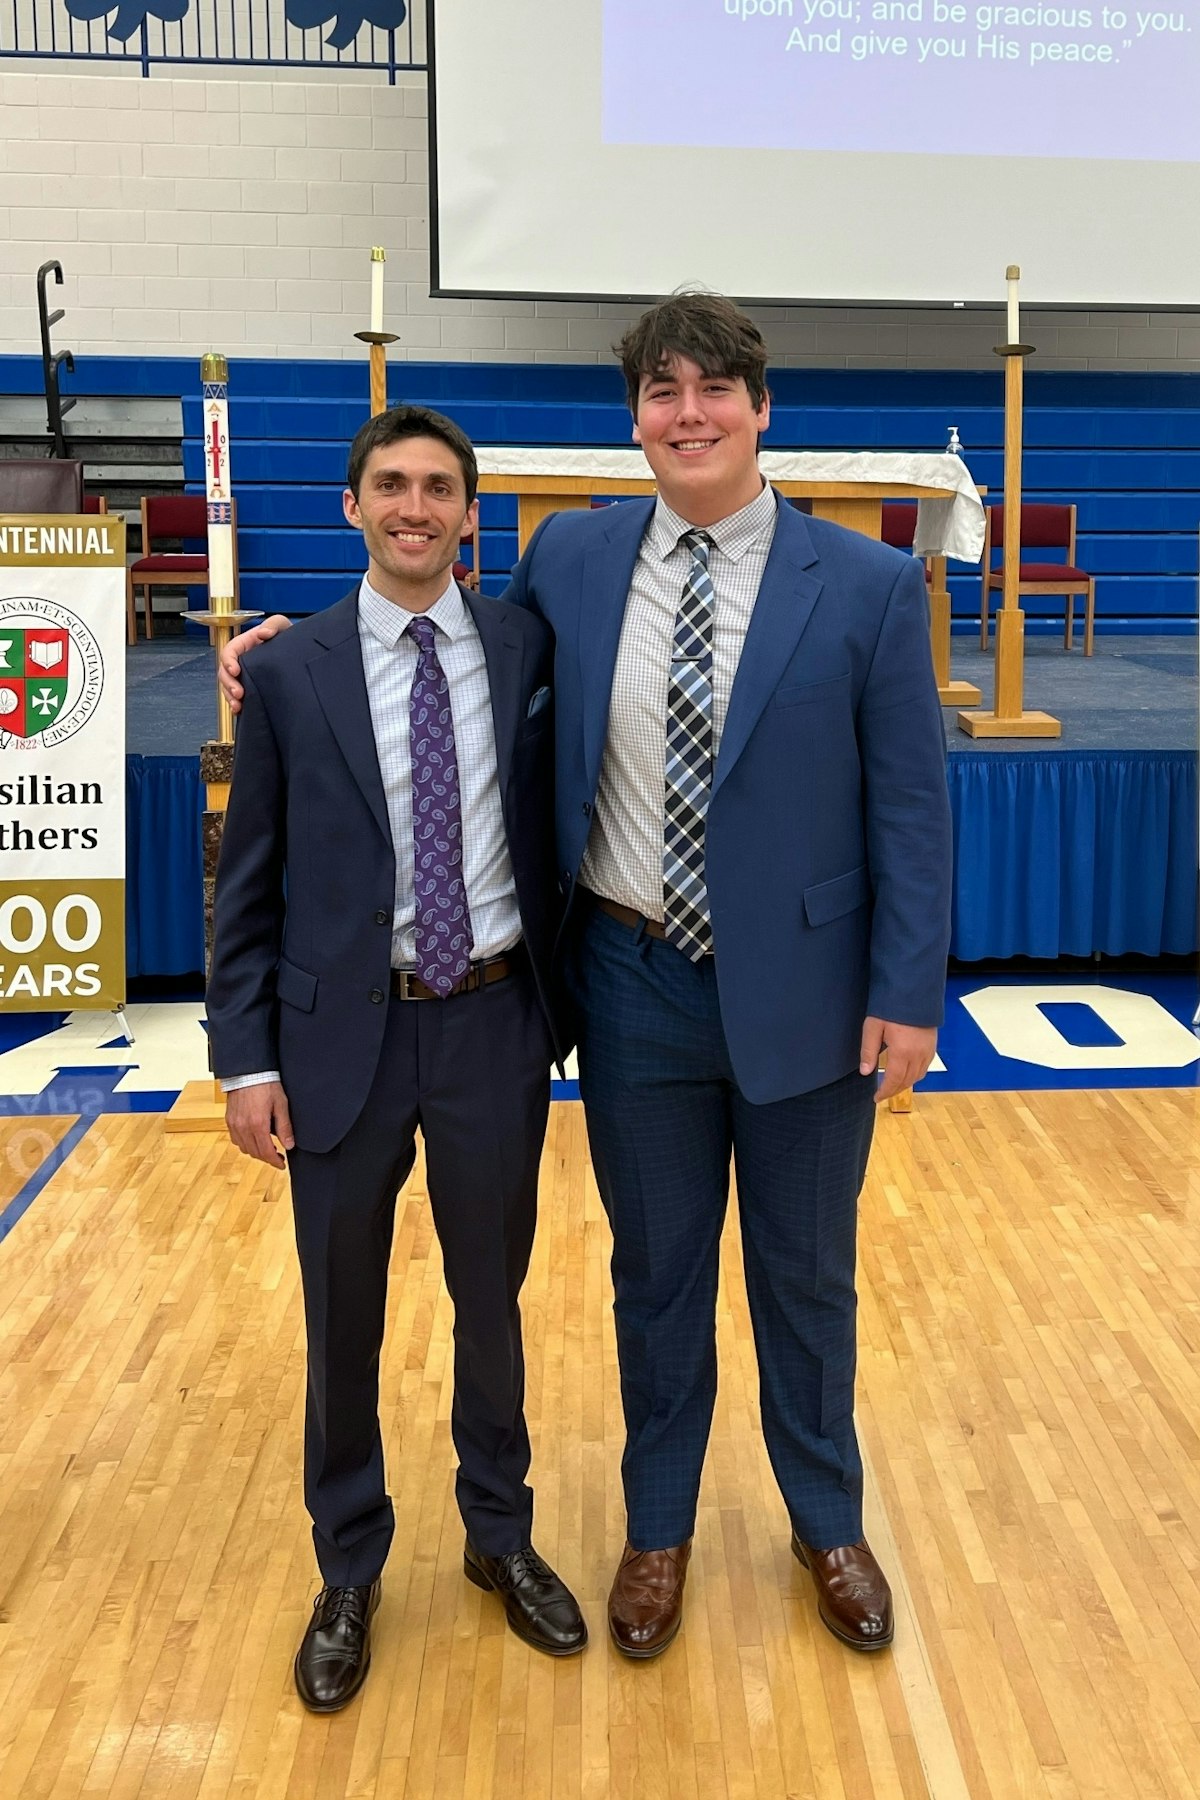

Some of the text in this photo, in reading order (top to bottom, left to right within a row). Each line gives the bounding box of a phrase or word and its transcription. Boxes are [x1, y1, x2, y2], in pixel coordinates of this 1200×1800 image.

[724, 0, 1192, 37] upon you; and be gracious to you.
[785, 27, 841, 53] And
[851, 30, 908, 60] give
[917, 37, 966, 63] you
[977, 34, 1020, 59] His
[15, 739, 37, 750] 1822
[0, 775, 103, 805] silian
[0, 963, 102, 998] ARS
